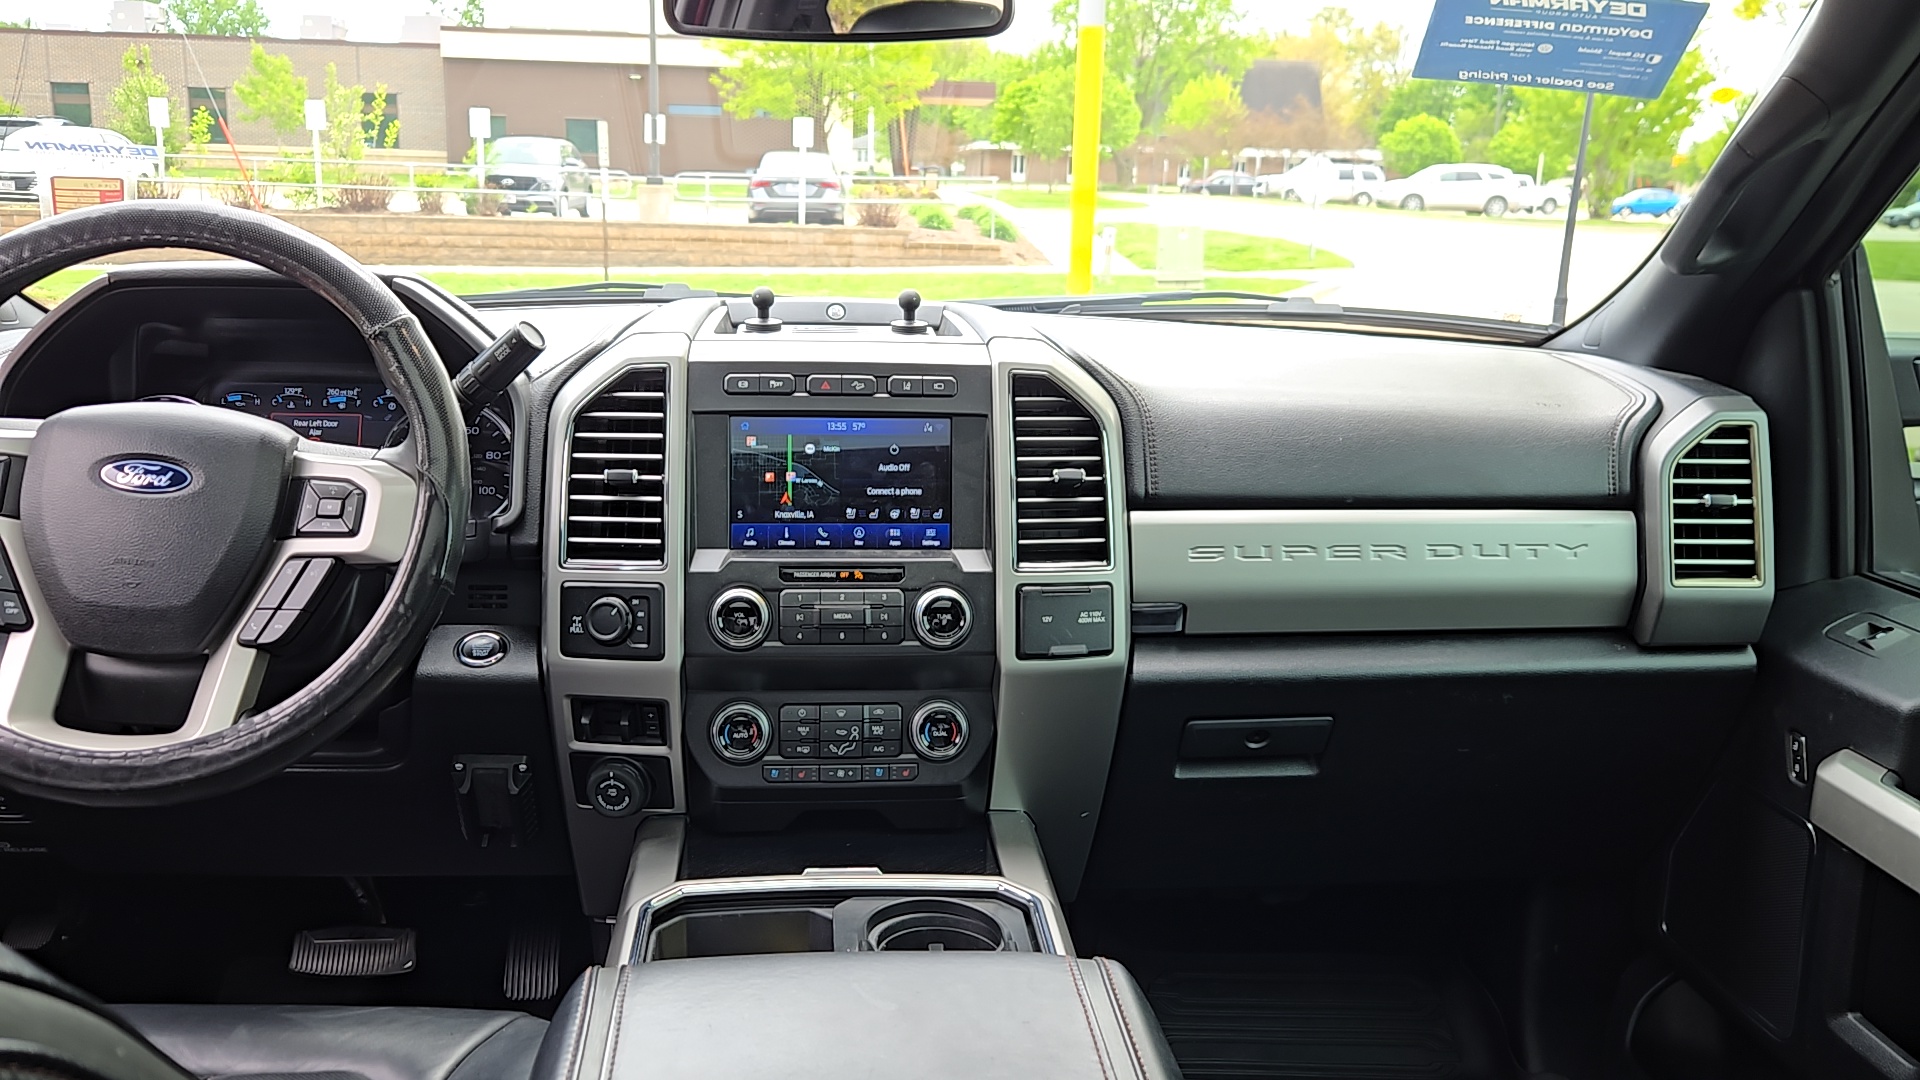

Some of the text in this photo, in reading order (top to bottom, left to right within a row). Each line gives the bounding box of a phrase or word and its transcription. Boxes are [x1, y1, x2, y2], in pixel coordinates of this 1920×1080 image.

[294, 420, 338, 428] Rear Left Door
[827, 422, 847, 431] 13:55
[309, 428, 323, 437] Ajar
[486, 451, 501, 460] 80
[878, 463, 910, 472] Audio Off
[479, 486, 496, 495] 100
[866, 486, 894, 496] Connect
[899, 486, 922, 498] phone
[736, 510, 744, 519] S
[774, 510, 807, 520] Knoxville,
[1188, 543, 1588, 562] SUPER DUTY
